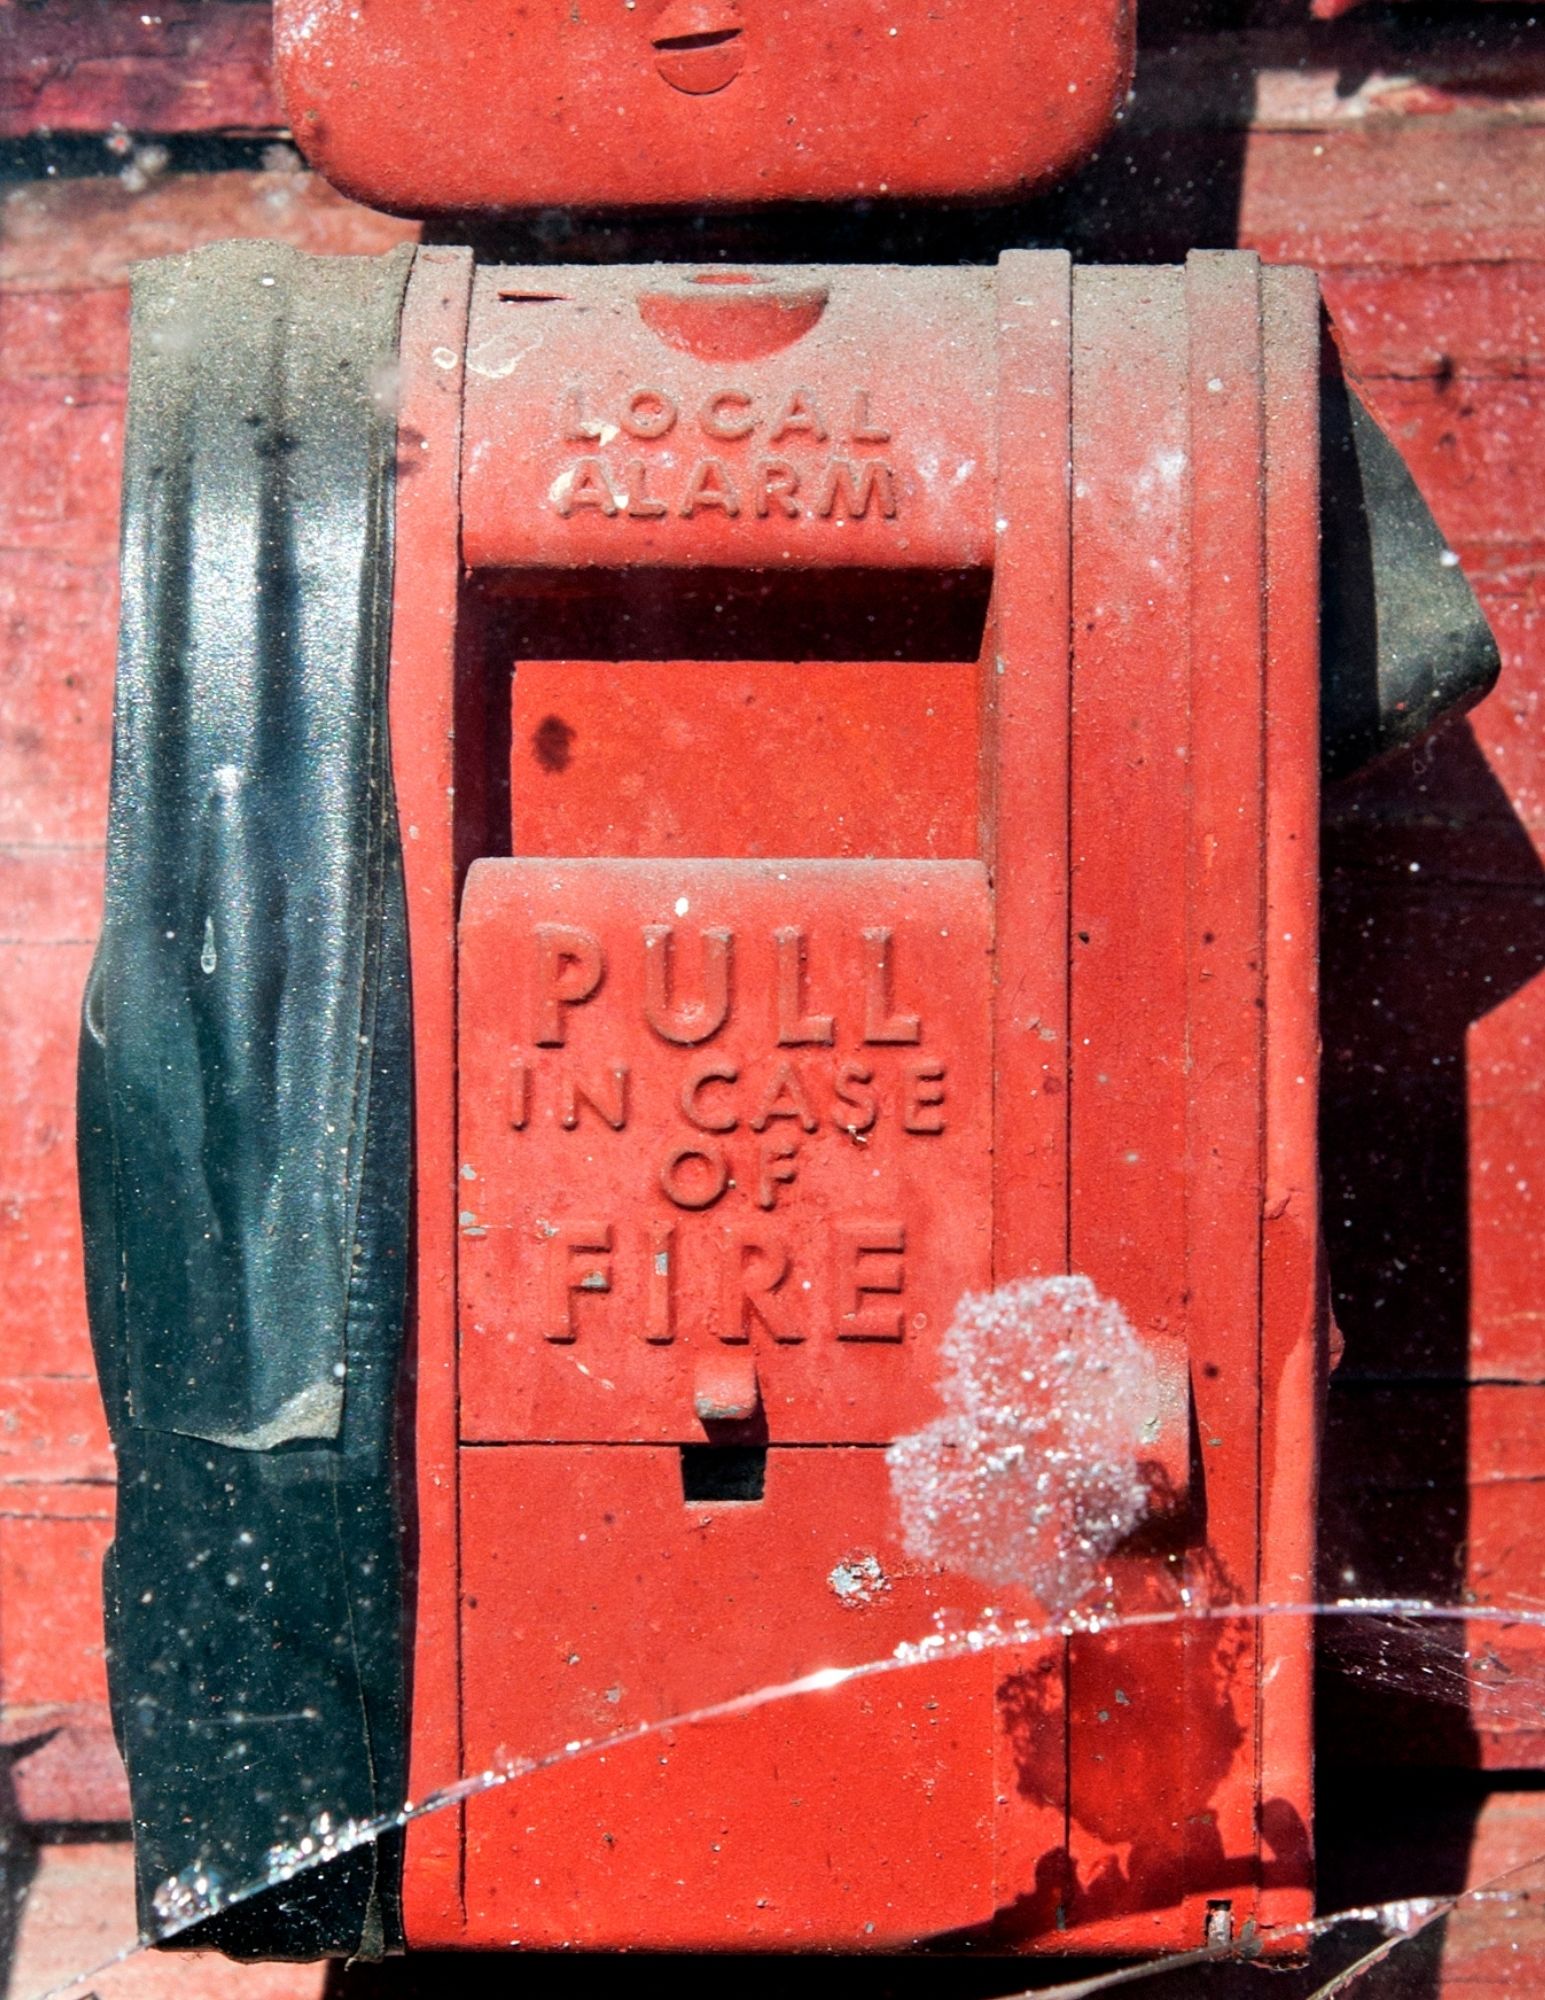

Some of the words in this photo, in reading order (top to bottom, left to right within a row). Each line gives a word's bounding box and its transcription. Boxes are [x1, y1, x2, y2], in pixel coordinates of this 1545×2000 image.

[562, 387, 891, 444] LOCAL
[556, 457, 898, 519] ALARM
[533, 922, 921, 1048] PULL
[510, 1063, 630, 1132] IN
[682, 1062, 946, 1136] CASE
[661, 1146, 797, 1212] OF
[543, 1219, 905, 1346] FIRE
